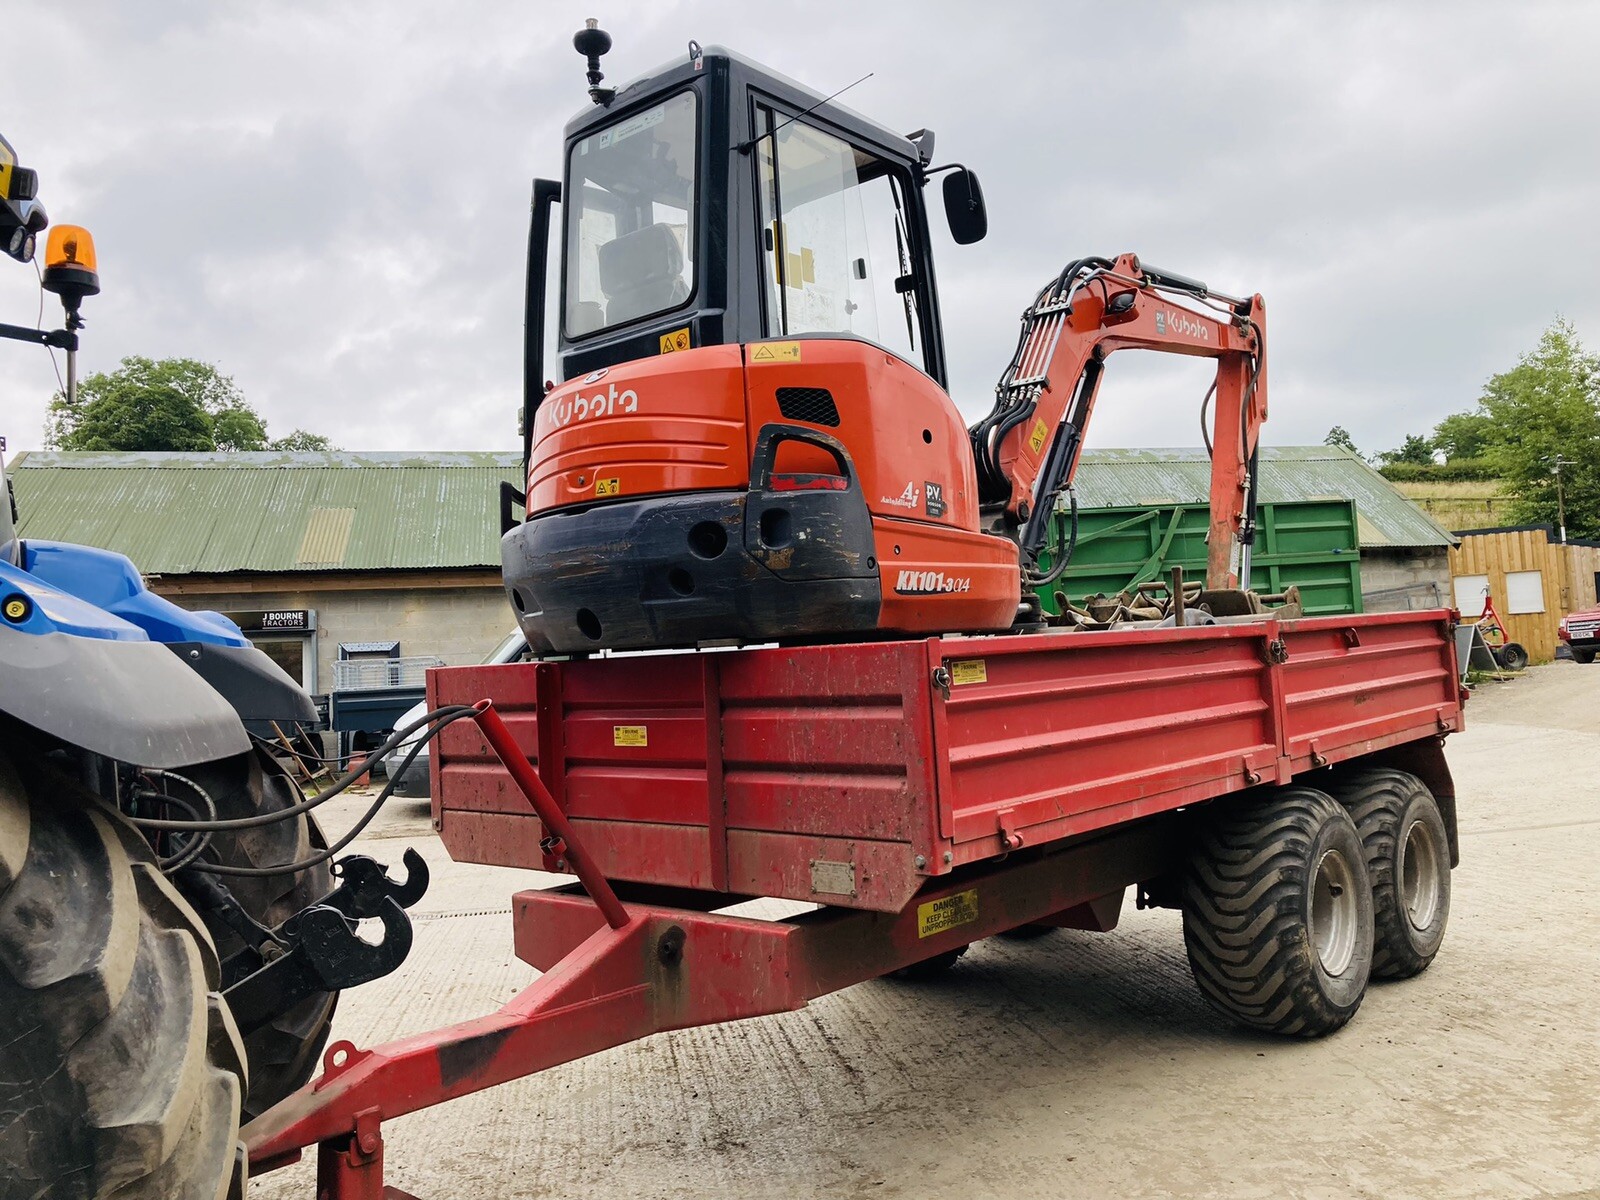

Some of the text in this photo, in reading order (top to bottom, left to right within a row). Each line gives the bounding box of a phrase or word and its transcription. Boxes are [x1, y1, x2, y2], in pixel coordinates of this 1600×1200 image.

[1167, 310, 1209, 341] Kubota
[548, 383, 638, 428] Kubota
[269, 612, 304, 620] BOURNE
[933, 896, 963, 911] DANGER
[922, 917, 959, 933] UNPROPPED
[926, 913, 942, 925] KEEP
